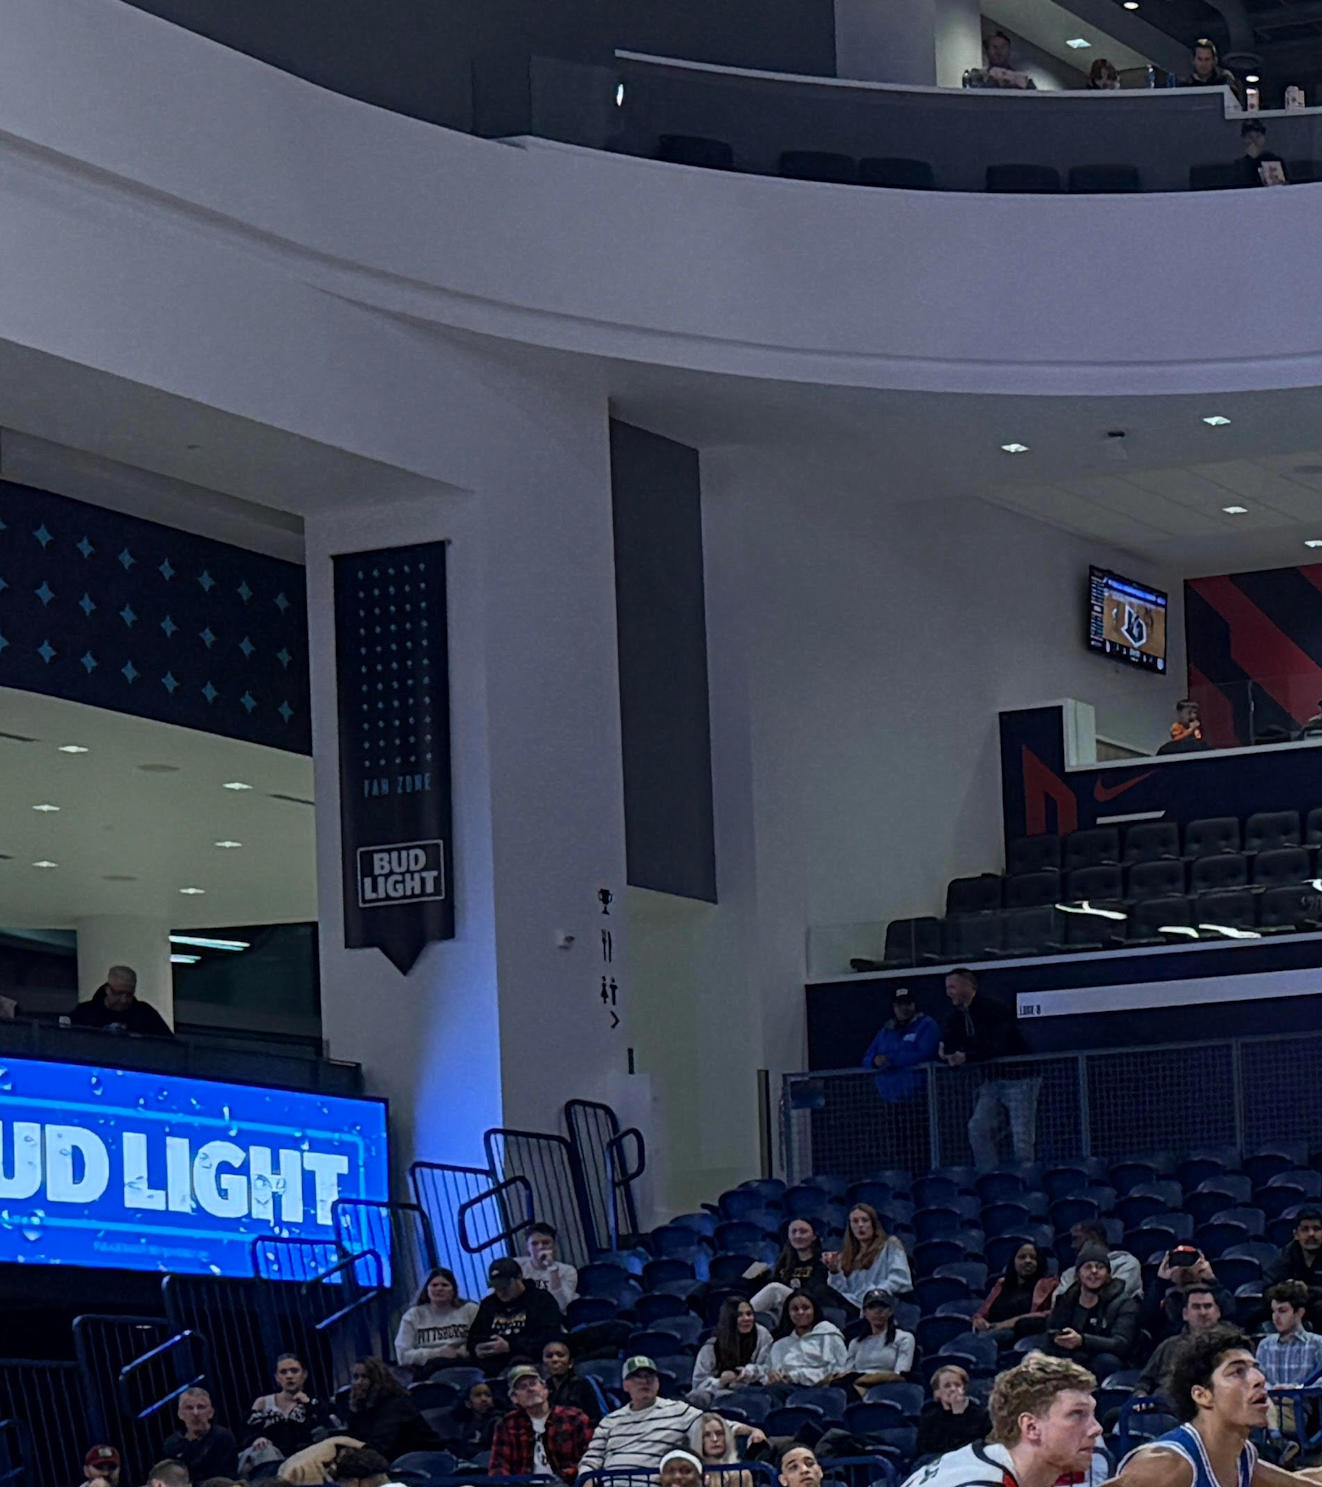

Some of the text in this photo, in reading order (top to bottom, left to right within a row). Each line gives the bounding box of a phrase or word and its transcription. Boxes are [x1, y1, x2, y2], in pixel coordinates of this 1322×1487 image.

[364, 773, 432, 797] FAN ZONE
[373, 848, 426, 875] BUD
[363, 871, 438, 900] LIGHT
[122, 1131, 349, 1226] LIGHT
